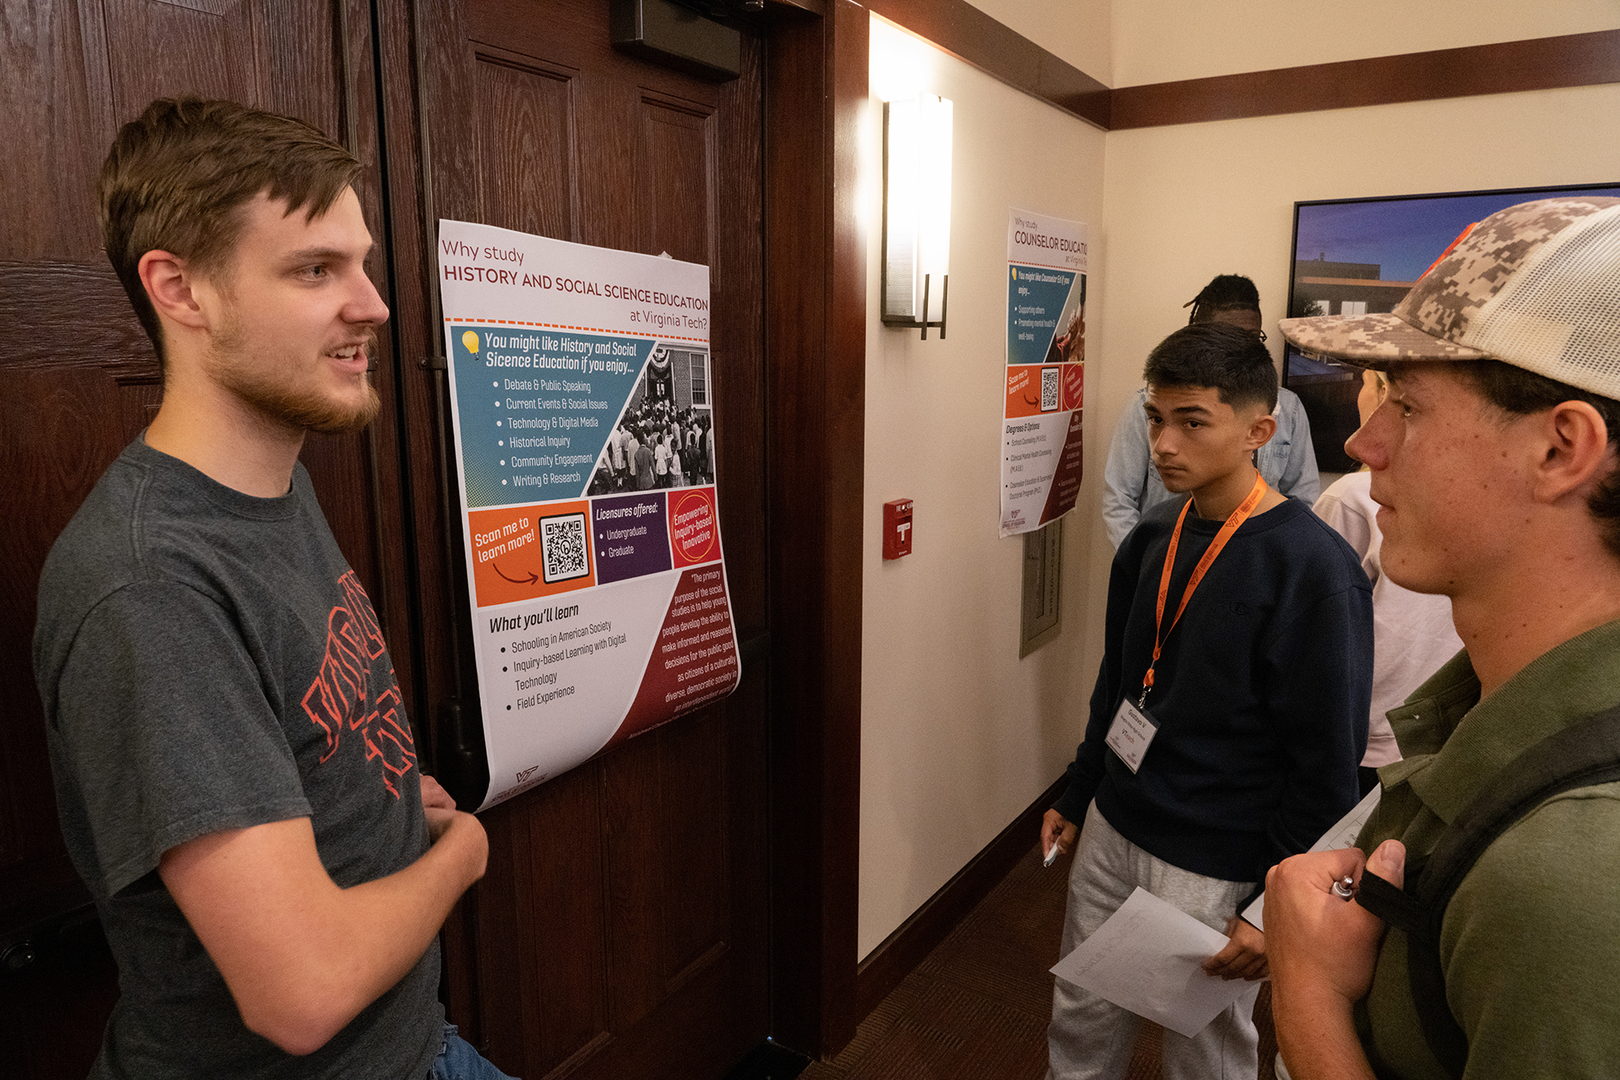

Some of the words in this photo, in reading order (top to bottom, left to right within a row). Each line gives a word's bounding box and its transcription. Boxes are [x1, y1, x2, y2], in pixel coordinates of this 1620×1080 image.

[1014, 216, 1024, 228] Why
[1026, 221, 1038, 231] study
[1014, 230, 1059, 250] COUNSELOR
[442, 240, 479, 261] Why
[484, 246, 524, 266] study
[444, 265, 518, 285] HISTORY
[522, 273, 552, 290] AND
[556, 277, 602, 296] SOCIAL
[604, 285, 651, 303] SCIENCE
[654, 292, 708, 311] EDUCATION
[630, 310, 641, 322] at
[642, 311, 680, 328] Virginia
[682, 315, 708, 330] Tech?
[484, 332, 507, 348] You
[510, 334, 539, 352] might
[542, 335, 558, 351] like
[560, 338, 593, 356] History
[596, 342, 610, 355] and
[612, 342, 636, 356] Social
[486, 352, 531, 368] Sicence
[533, 353, 579, 370] Education
[581, 357, 587, 373] if
[589, 359, 604, 373] you
[606, 361, 634, 375] enjoy...
[504, 379, 532, 390] Debate
[533, 379, 539, 390] &
[541, 379, 561, 391] Public
[563, 380, 591, 394] Speaking
[1009, 376, 1018, 385] Scan
[506, 398, 536, 409] Current
[538, 398, 561, 409] Events
[562, 398, 568, 409] &
[569, 398, 588, 409] Social
[588, 399, 608, 410] Issues
[508, 417, 550, 430] Technology
[552, 417, 558, 428] &
[559, 417, 579, 430] Digital
[580, 417, 599, 428] Media
[1006, 425, 1023, 435] Degrees
[510, 436, 547, 448] Historical
[548, 436, 570, 448] Inquiry
[511, 456, 553, 468] Community
[554, 454, 593, 467] Engagement
[512, 475, 542, 487] Writing
[543, 473, 548, 485] &
[550, 472, 581, 484] Research
[596, 507, 632, 521] Licensures
[633, 502, 658, 518] offered:
[674, 504, 709, 526] Empowering
[475, 530, 501, 547] Scan
[503, 522, 517, 536] me
[518, 517, 529, 530] to
[606, 526, 647, 541] Undergraduate
[674, 517, 712, 540] Inquiry-based
[478, 545, 506, 563] learn
[508, 531, 535, 552] more!
[682, 531, 711, 550] Innovative
[608, 546, 634, 558] Graduate
[703, 570, 721, 582] primary
[675, 592, 694, 606] purpose
[695, 589, 700, 598] of
[700, 587, 708, 597] the
[709, 584, 723, 595] social
[672, 605, 690, 618] studies
[691, 603, 695, 612] is
[696, 602, 701, 611] to
[702, 598, 712, 610] help
[713, 596, 726, 608] young
[489, 615, 521, 633] What
[524, 608, 552, 630] you’ll
[555, 604, 579, 621] learn
[662, 624, 680, 639] people
[680, 619, 700, 632] develop
[701, 616, 709, 626] the
[709, 612, 724, 623] ability
[724, 611, 729, 619] to
[512, 636, 549, 653] Schooling
[550, 634, 557, 644] in
[558, 626, 589, 642] American
[590, 620, 612, 634] Society
[662, 642, 677, 654] make
[677, 635, 700, 648] informed
[700, 632, 709, 642] and
[710, 625, 732, 639] reasoned
[514, 652, 564, 672] Inquiry-based
[565, 642, 594, 659] Learning
[594, 638, 607, 652] with
[608, 633, 627, 649] Digital
[665, 655, 690, 670] decisions
[690, 651, 698, 661] for
[699, 649, 707, 658] the
[708, 645, 722, 657] public
[723, 640, 734, 653] good
[678, 673, 684, 682] as
[684, 667, 704, 679] citizens
[704, 663, 710, 673] of
[710, 662, 714, 670] a
[714, 655, 736, 668] culturally
[515, 672, 557, 691] Technology
[665, 689, 686, 703] diverse,
[686, 678, 714, 695] democratic
[715, 672, 732, 685] society
[732, 670, 737, 679] in
[516, 696, 535, 710] Field
[537, 684, 575, 704] Experience
[516, 765, 539, 783] VT
